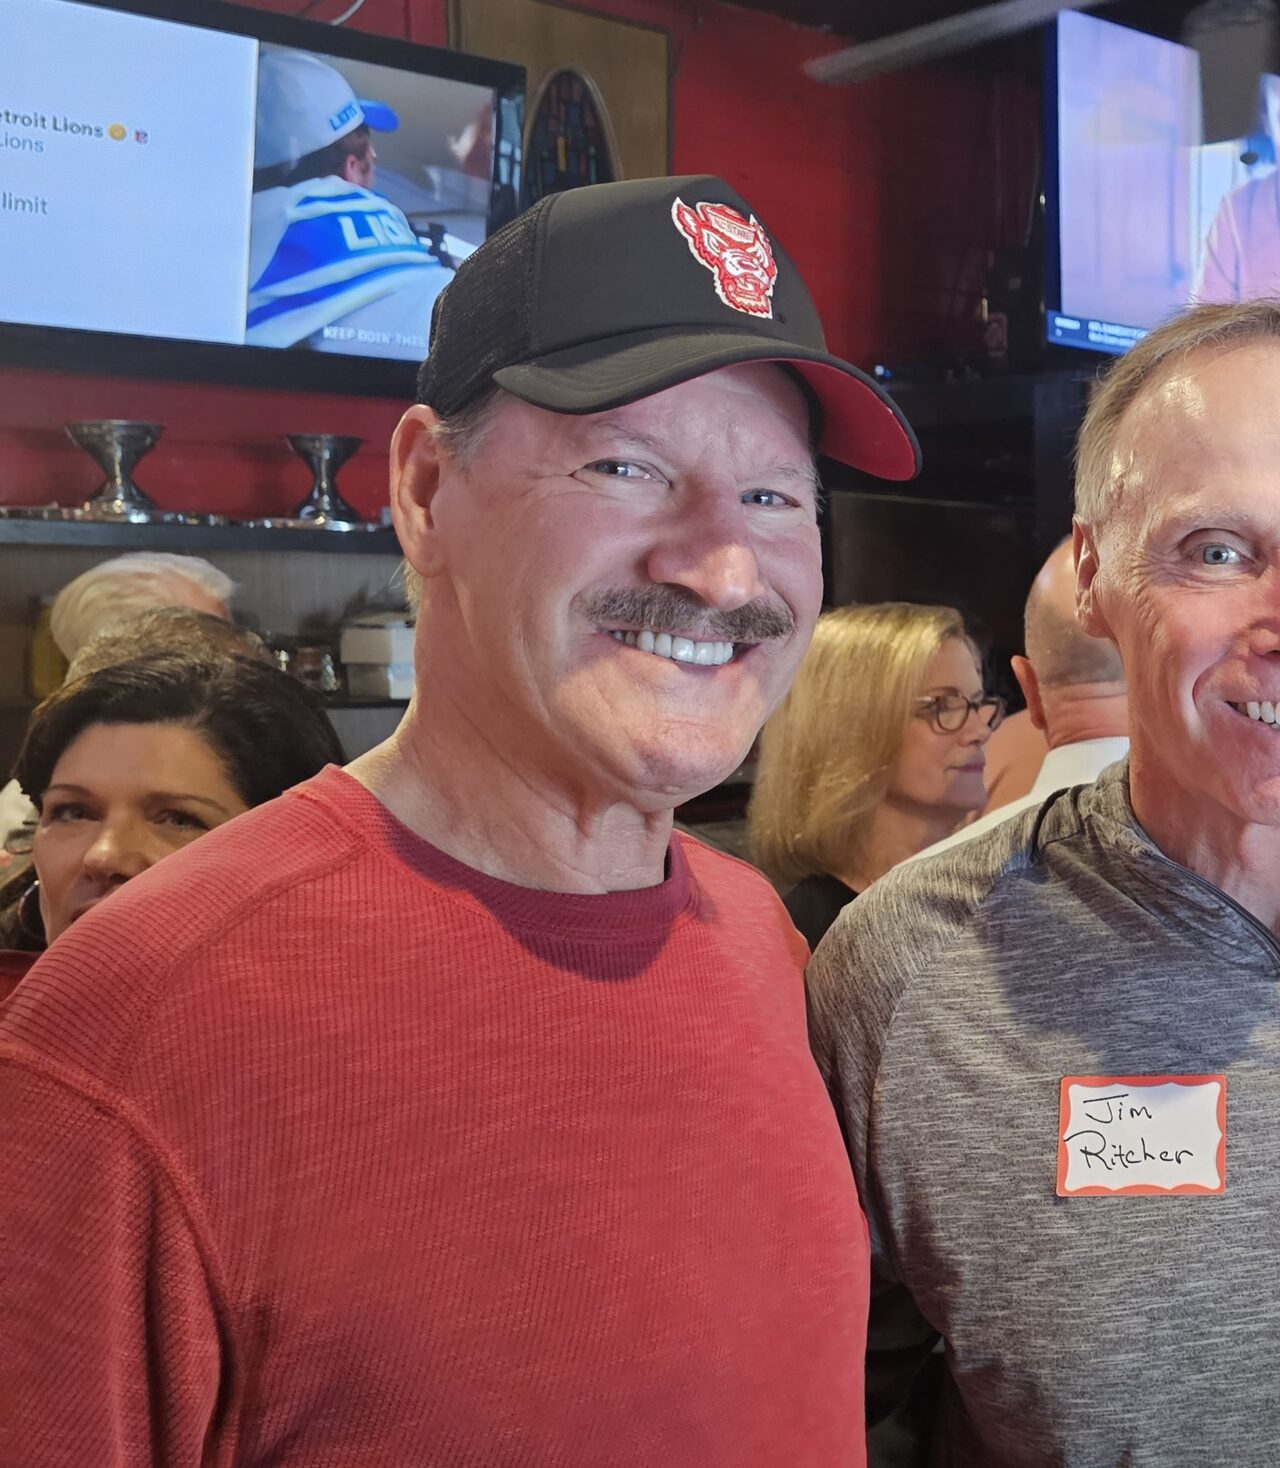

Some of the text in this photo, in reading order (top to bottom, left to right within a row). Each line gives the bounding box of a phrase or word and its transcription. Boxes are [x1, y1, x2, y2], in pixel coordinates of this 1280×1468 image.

[0, 108, 104, 139] troit Lions
[2, 191, 48, 216] limit
[1083, 1093, 1153, 1124] Jim
[1063, 1130, 1194, 1170] Ritcher
